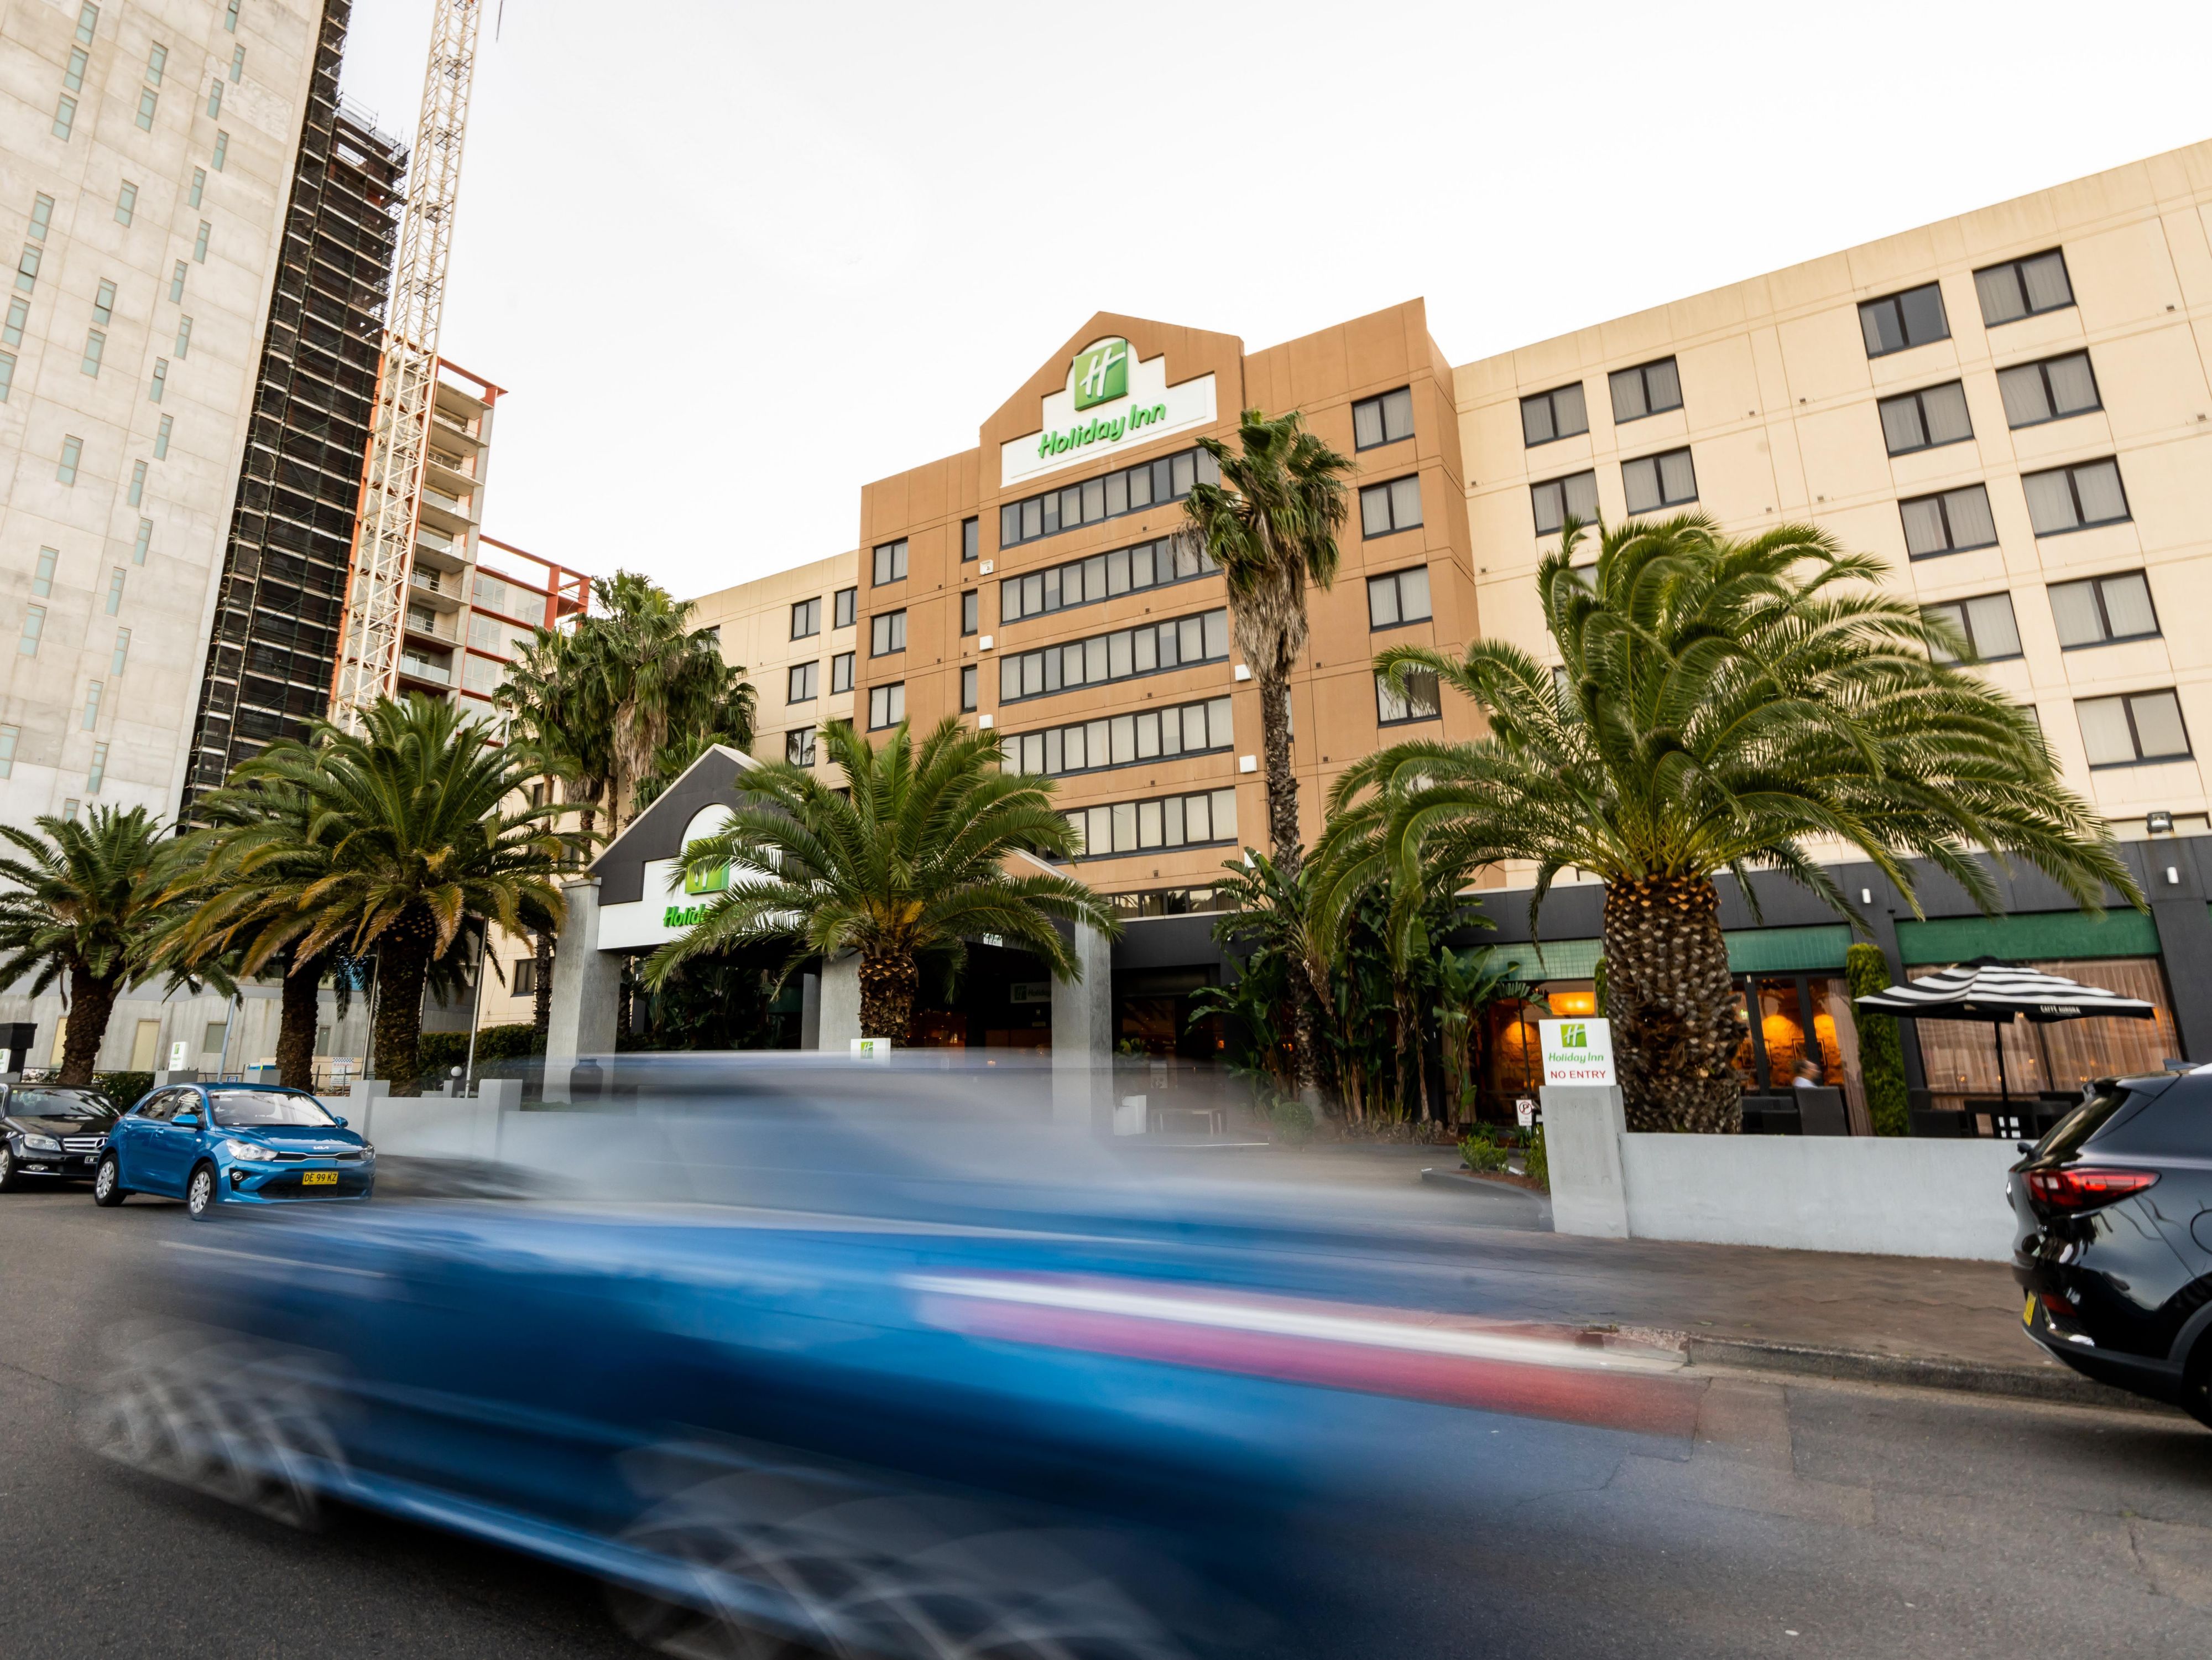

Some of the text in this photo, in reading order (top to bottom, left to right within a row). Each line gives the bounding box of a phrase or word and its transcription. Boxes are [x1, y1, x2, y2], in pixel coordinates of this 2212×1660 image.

[1038, 404, 1166, 459] Holiday Inn
[663, 903, 713, 928] Holid
[1548, 1052, 1604, 1064] Holiday Inn
[1551, 1070, 1606, 1079] NO ENTRY
[327, 1173, 337, 1182] KZ
